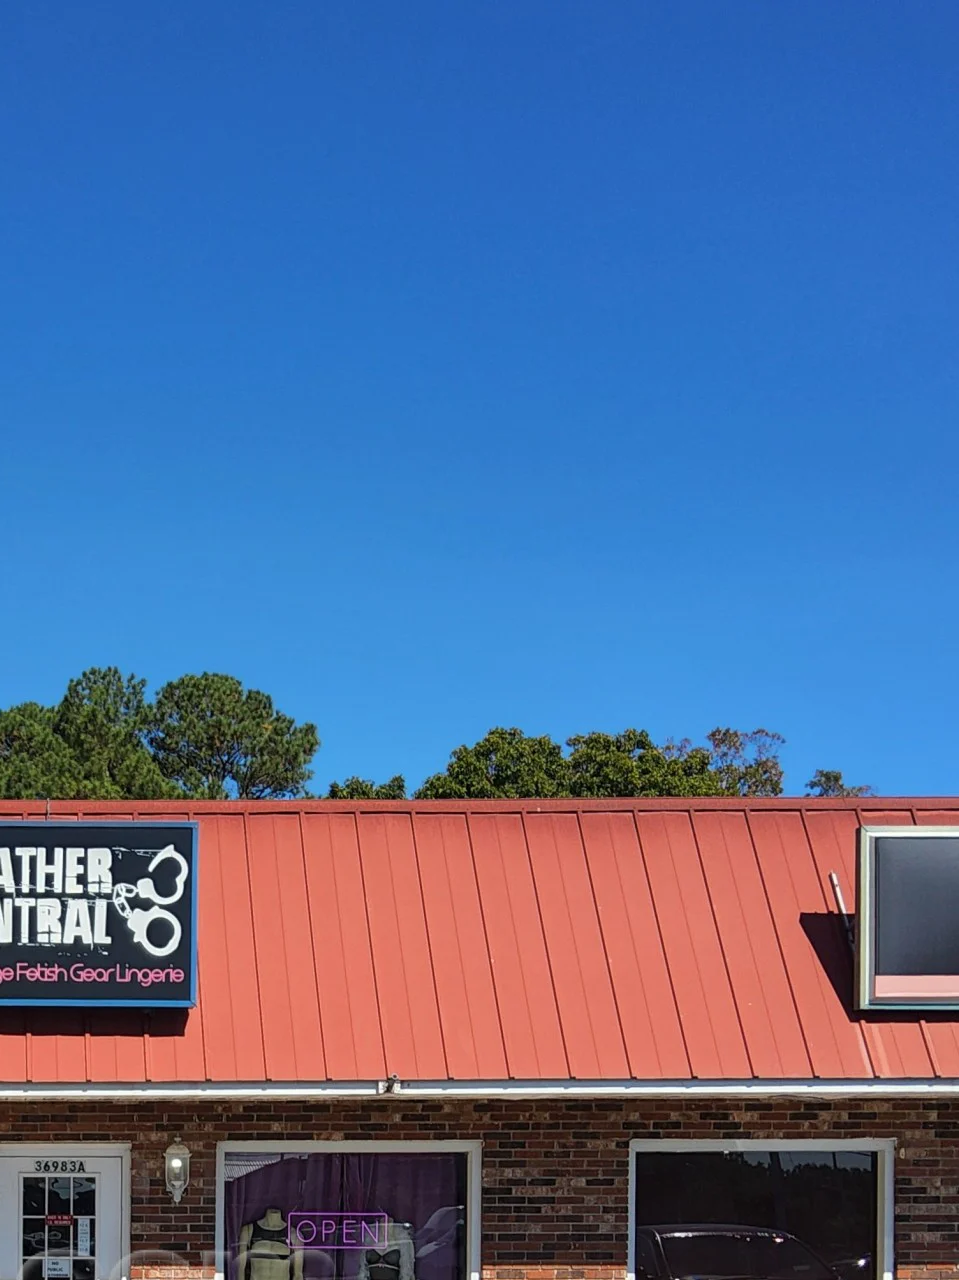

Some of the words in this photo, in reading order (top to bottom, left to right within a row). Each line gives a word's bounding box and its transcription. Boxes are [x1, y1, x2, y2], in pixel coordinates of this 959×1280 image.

[16, 962, 68, 982] Fetish
[69, 963, 115, 982] Gear
[115, 963, 185, 987] Lingerie
[35, 1160, 86, 1173] 36983A
[296, 1219, 379, 1245] OPEN
